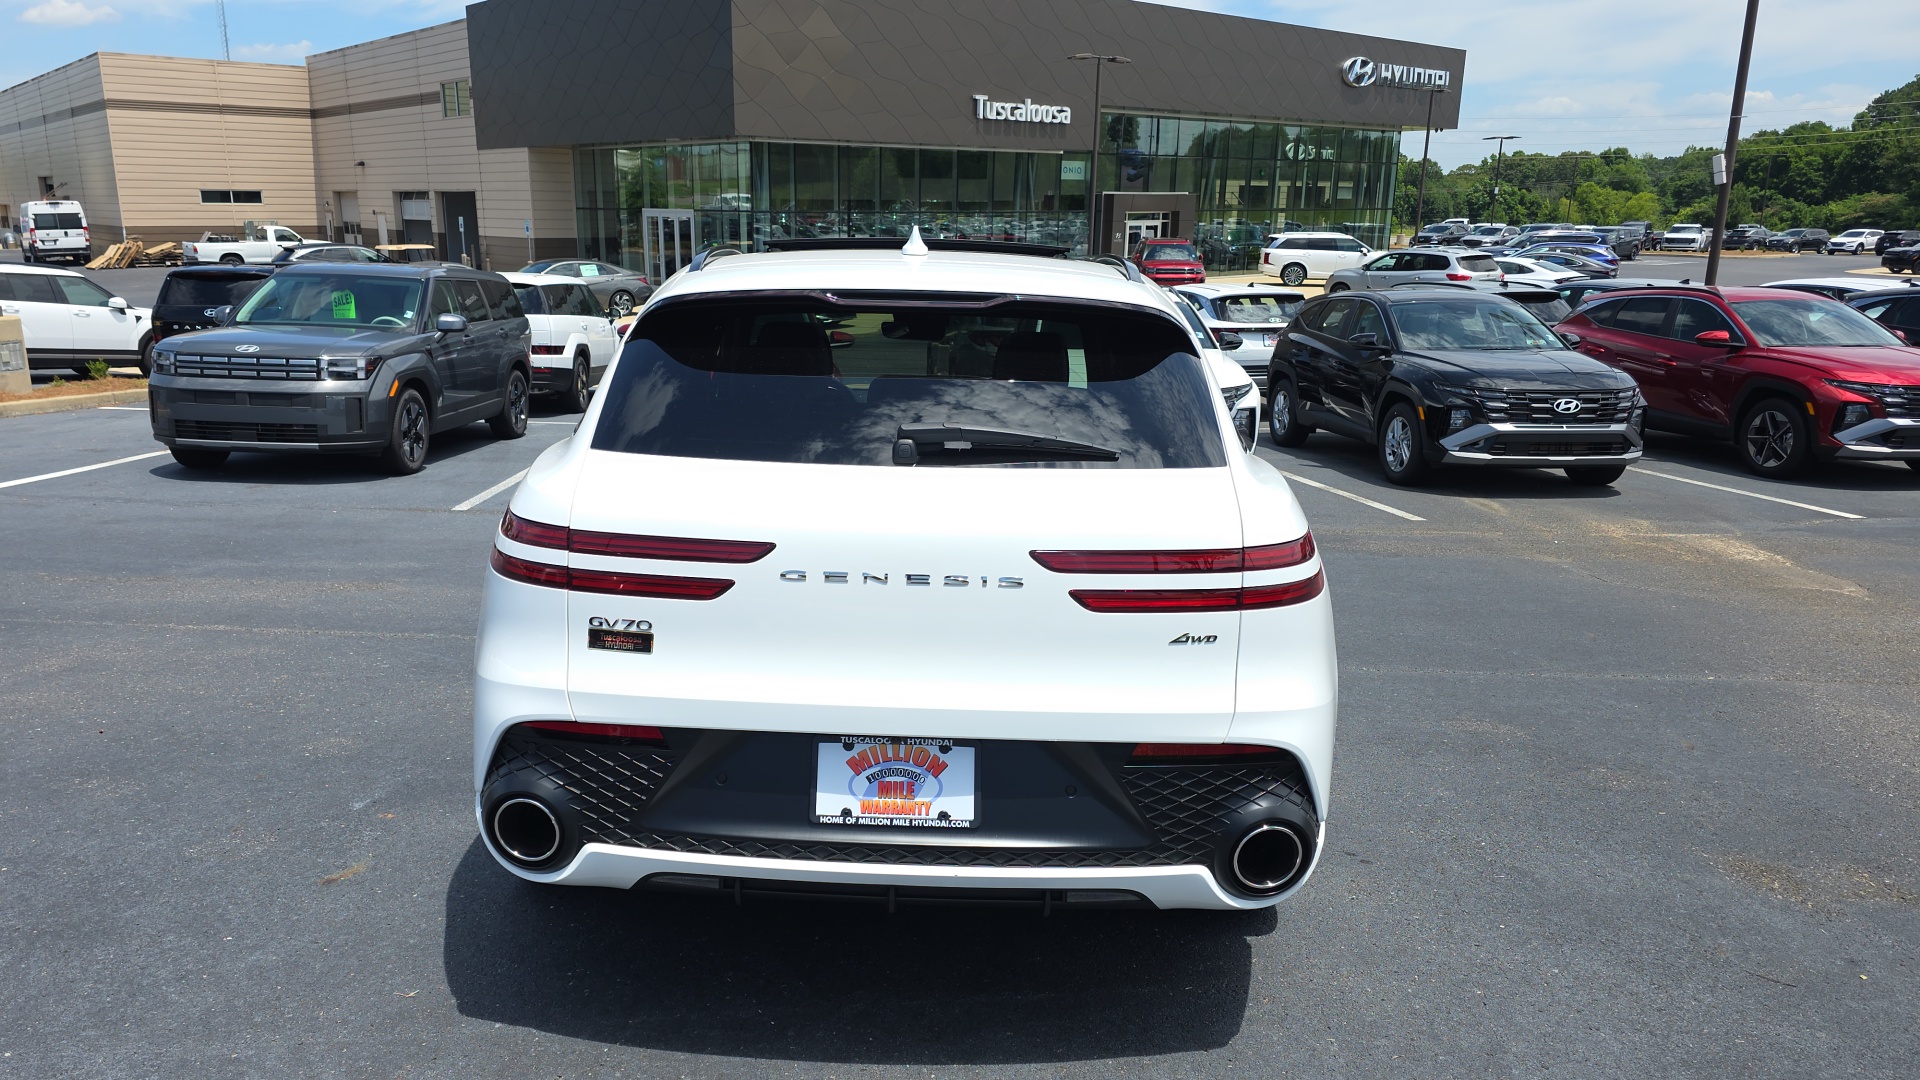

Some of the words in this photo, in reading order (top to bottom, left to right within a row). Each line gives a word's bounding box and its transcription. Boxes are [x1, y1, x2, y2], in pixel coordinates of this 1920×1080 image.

[1378, 63, 1450, 88] HYUNDAI
[973, 94, 1071, 124] Tuscaloosa
[333, 292, 353, 307] SALE!
[779, 569, 1025, 590] GENESIS
[588, 616, 653, 631] GV70
[605, 641, 635, 650] HYUNDAI
[1168, 632, 1218, 645] 4WD
[907, 738, 953, 747] HYUNDAI
[845, 743, 949, 779] MILLION
[878, 780, 915, 800] MILE
[860, 800, 933, 817] WARRANTY
[819, 816, 844, 824] HOME
[845, 817, 857, 825] OF
[858, 818, 891, 827] MILLION
[892, 819, 910, 827] MILE
[912, 820, 970, 828] HYUNDAI.COM
